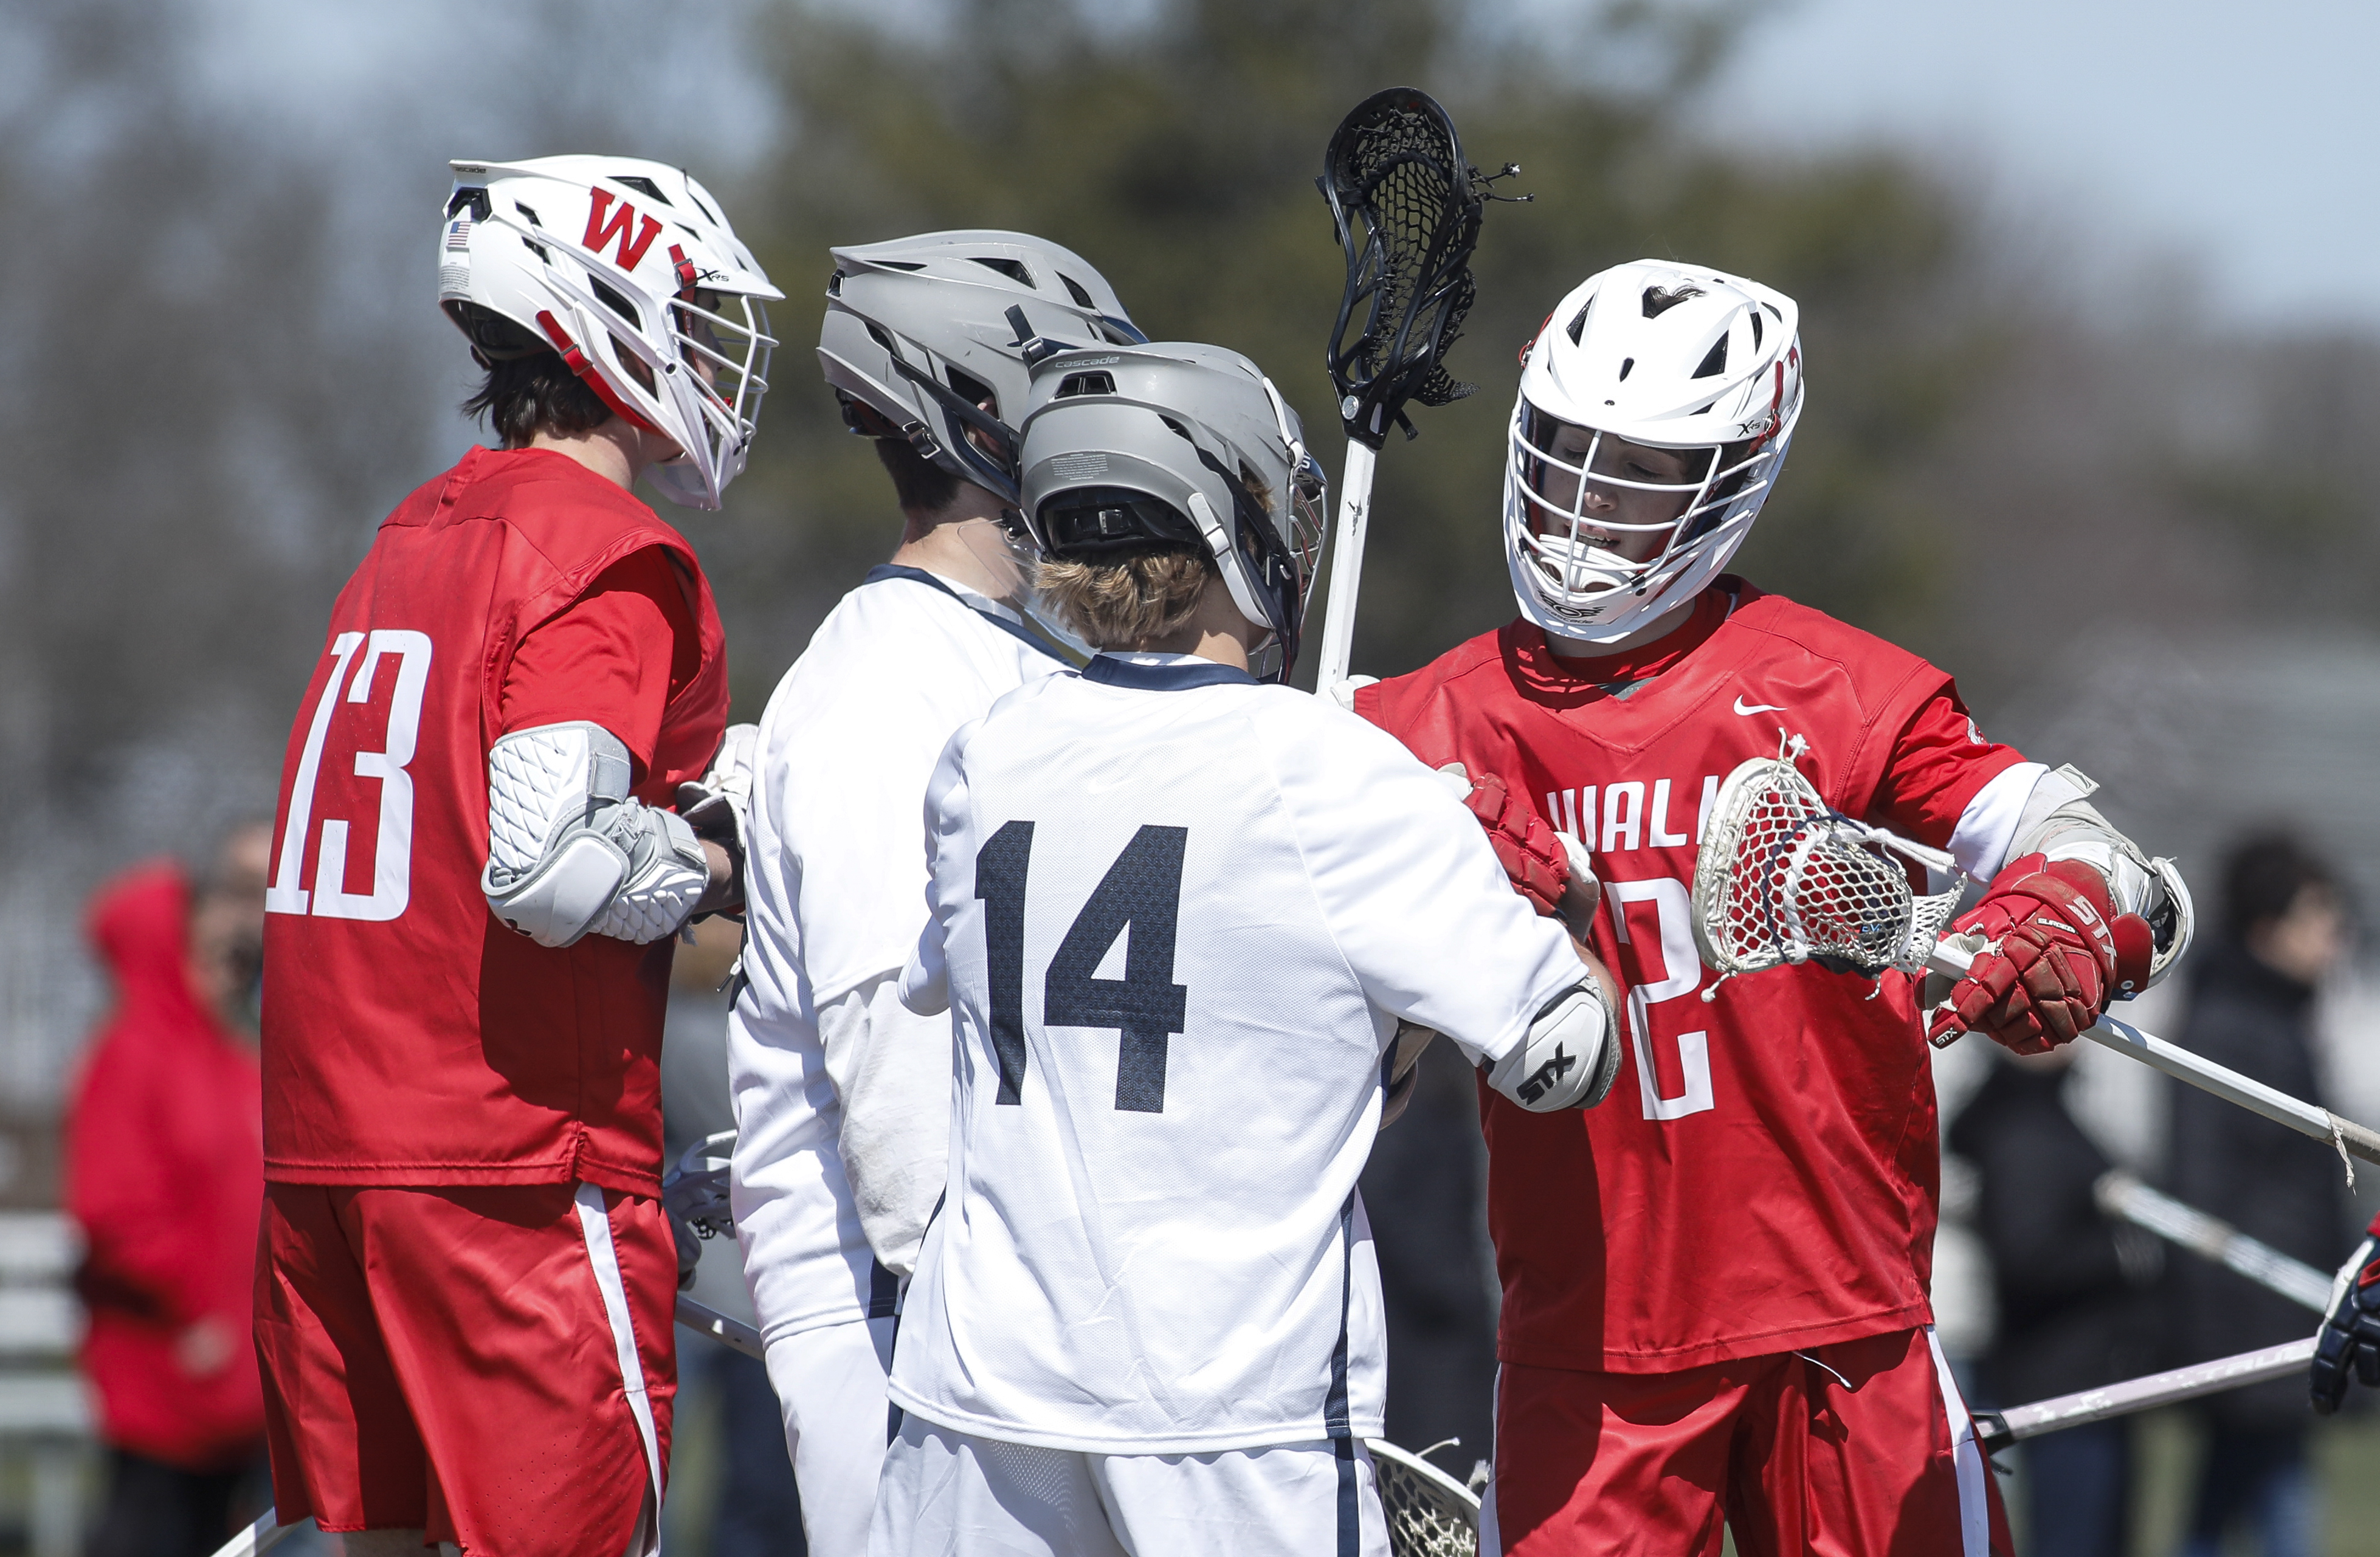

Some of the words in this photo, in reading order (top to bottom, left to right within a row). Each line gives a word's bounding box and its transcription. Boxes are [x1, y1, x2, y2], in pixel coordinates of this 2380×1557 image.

[582, 186, 663, 272] W
[694, 267, 730, 282] XRS
[1055, 356, 1120, 368] cascade
[1737, 419, 1761, 438] XRS
[1544, 607, 1594, 624] cascade
[265, 629, 433, 922] 13
[2064, 895, 2117, 971] STX
[974, 820, 1188, 1114] 14
[1603, 877, 1715, 1121] 2
[1936, 1027, 1957, 1046] STX
[1516, 1040, 1577, 1106] STX
